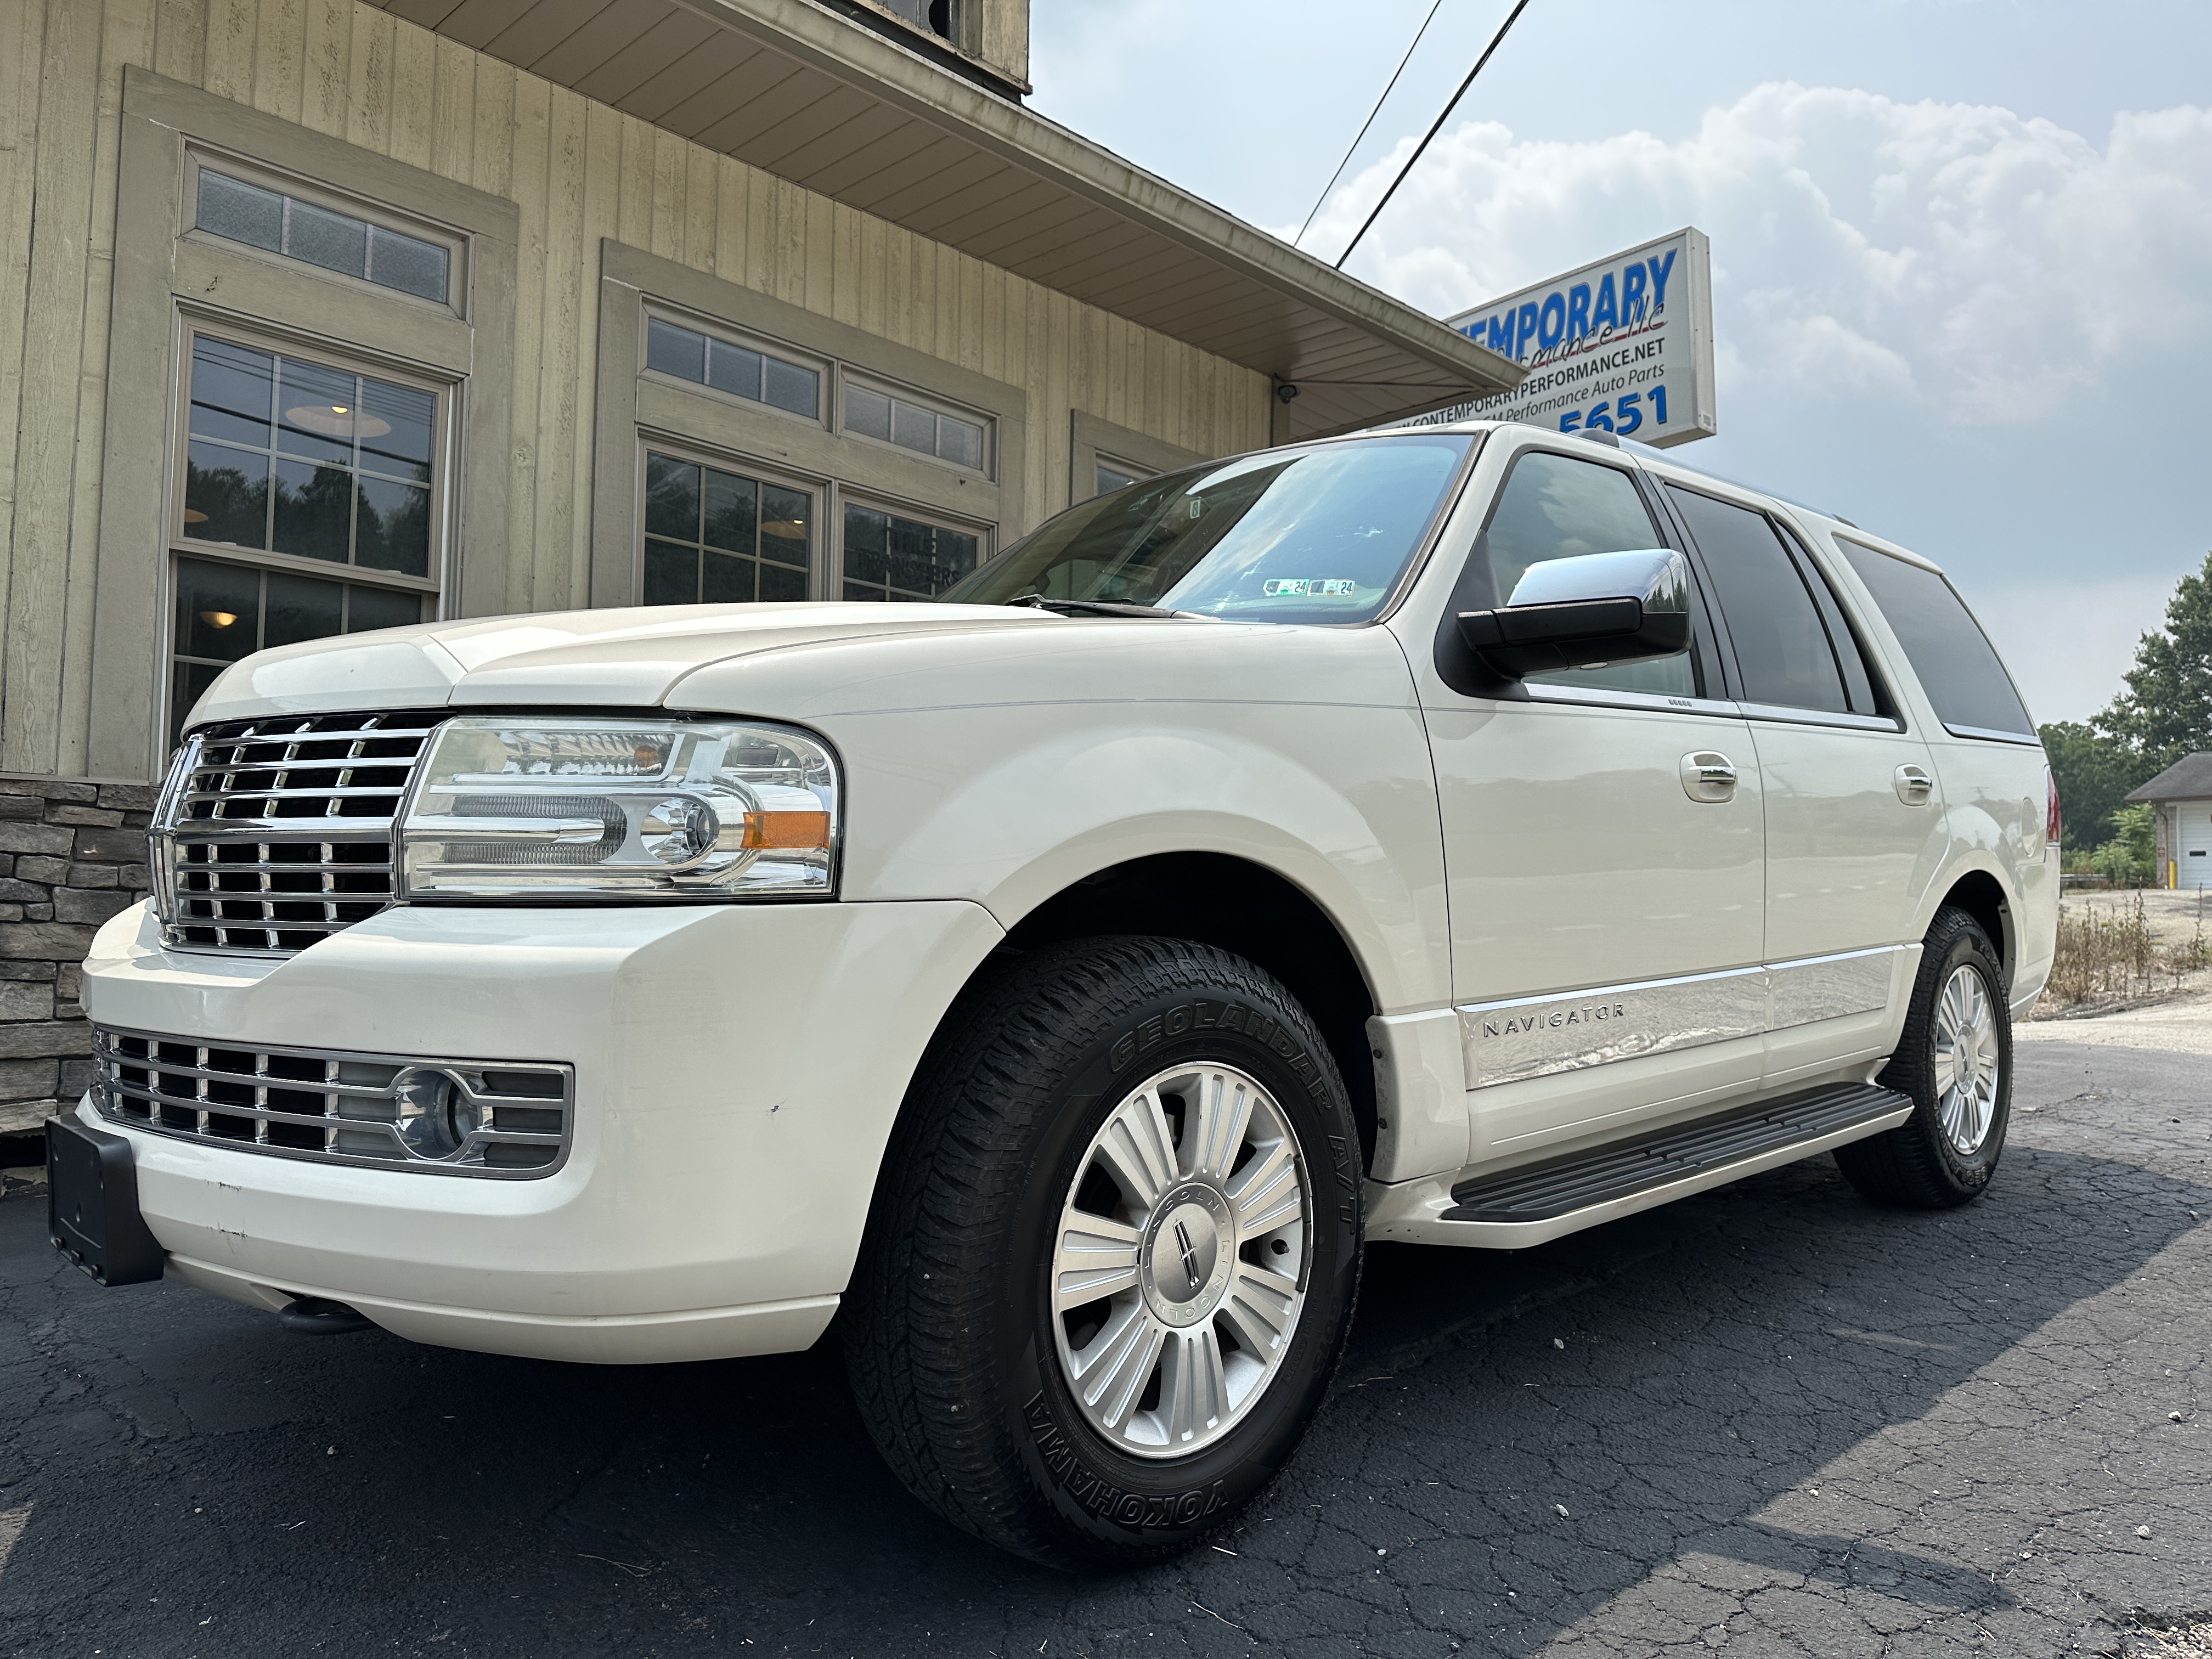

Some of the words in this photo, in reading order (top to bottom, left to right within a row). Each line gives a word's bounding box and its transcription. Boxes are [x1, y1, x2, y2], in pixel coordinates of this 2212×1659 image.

[1460, 247, 1678, 360] EMPORARY
[1506, 386, 1588, 421] Performance
[1592, 376, 1624, 397] Auto
[1628, 363, 1664, 386] Parts
[1294, 581, 1306, 592] 24
[1341, 582, 1352, 594] 24
[1483, 1002, 1624, 1037] NAVIGATOR
[1110, 1002, 1334, 1116] GEOLANDAR
[1328, 1135, 1355, 1235] A/T
[1144, 1190, 1220, 1269] LINCOLN
[1155, 1239, 1230, 1320] LINCOLN
[1023, 1389, 1231, 1526] YOKOHAMA
